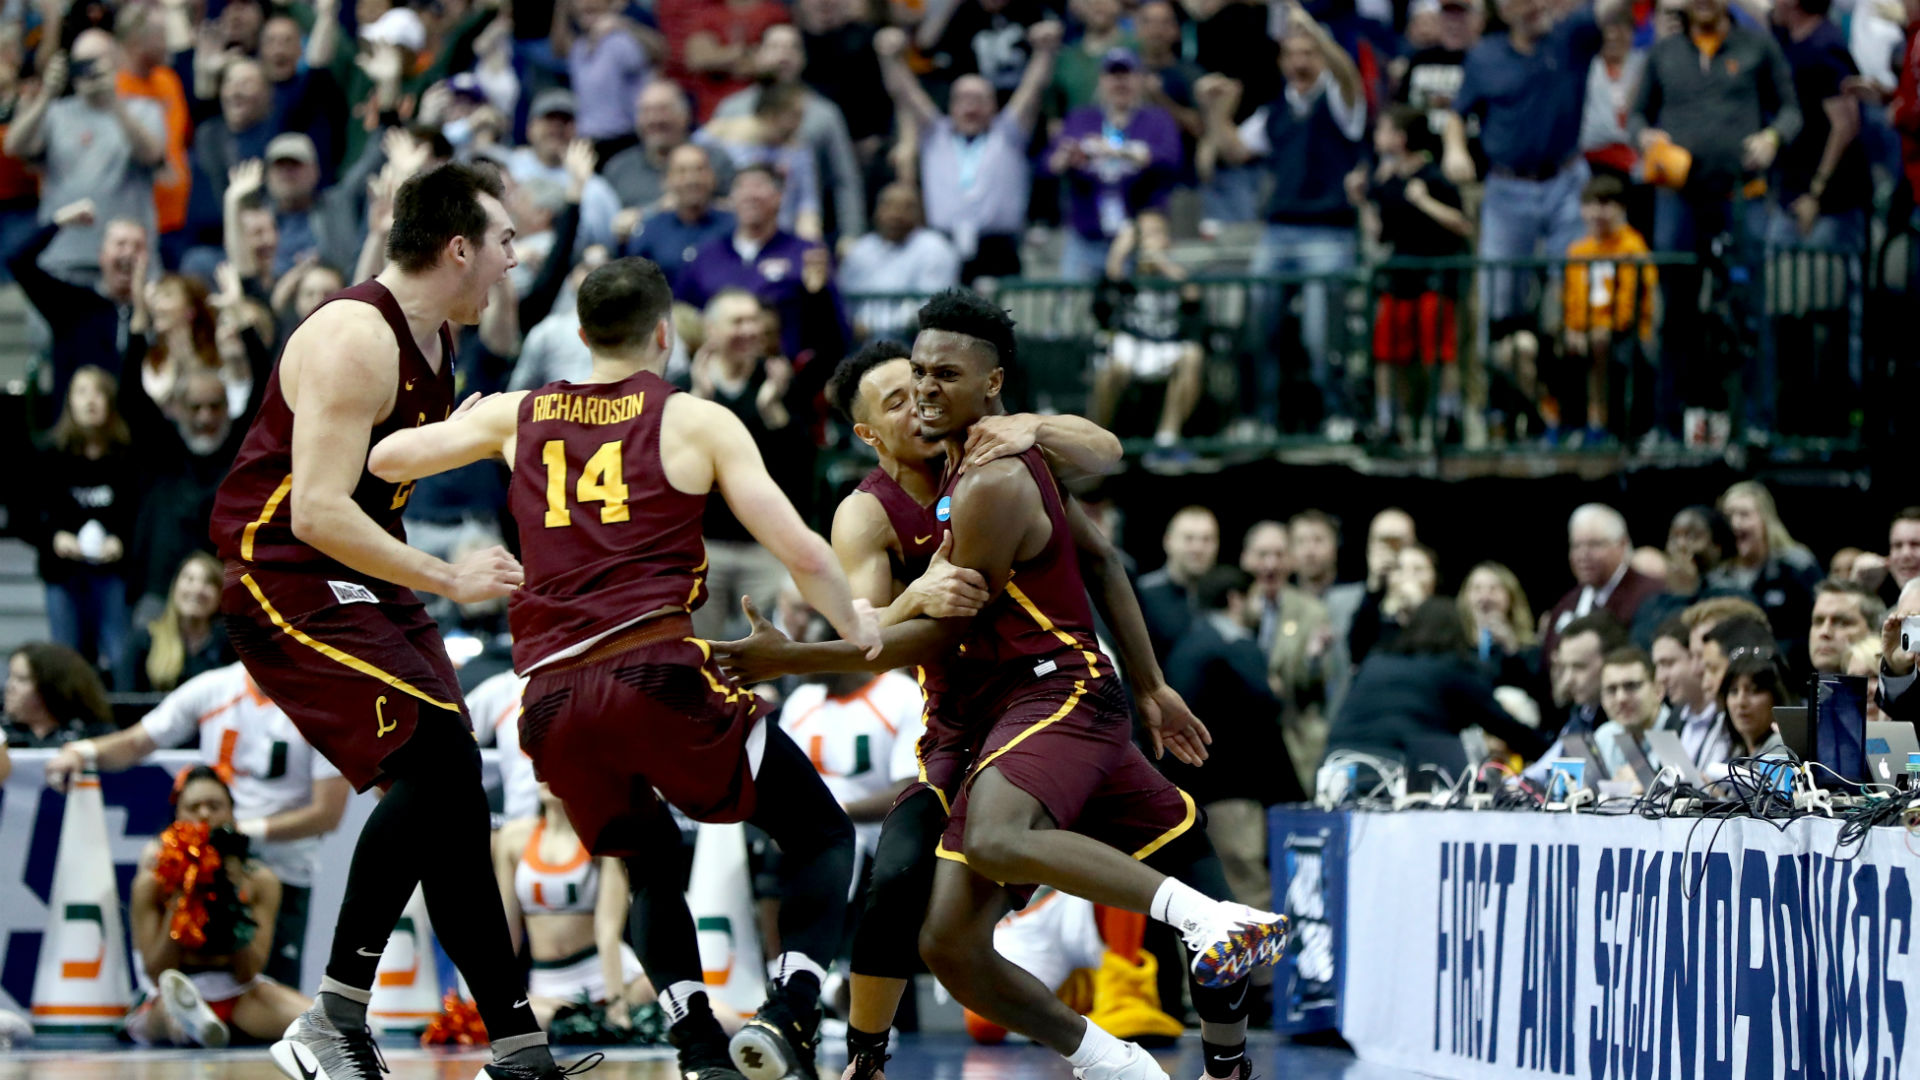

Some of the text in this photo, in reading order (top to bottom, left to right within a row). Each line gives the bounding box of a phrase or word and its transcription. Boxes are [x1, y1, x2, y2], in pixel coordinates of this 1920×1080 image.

[532, 391, 645, 425] RICHARDSON
[542, 439, 630, 528] 14
[375, 695, 397, 738] L
[810, 734, 871, 777] U
[1434, 841, 1518, 1064] FIRST
[1516, 843, 1580, 1076] AND
[1589, 847, 1733, 1080] SECOND
